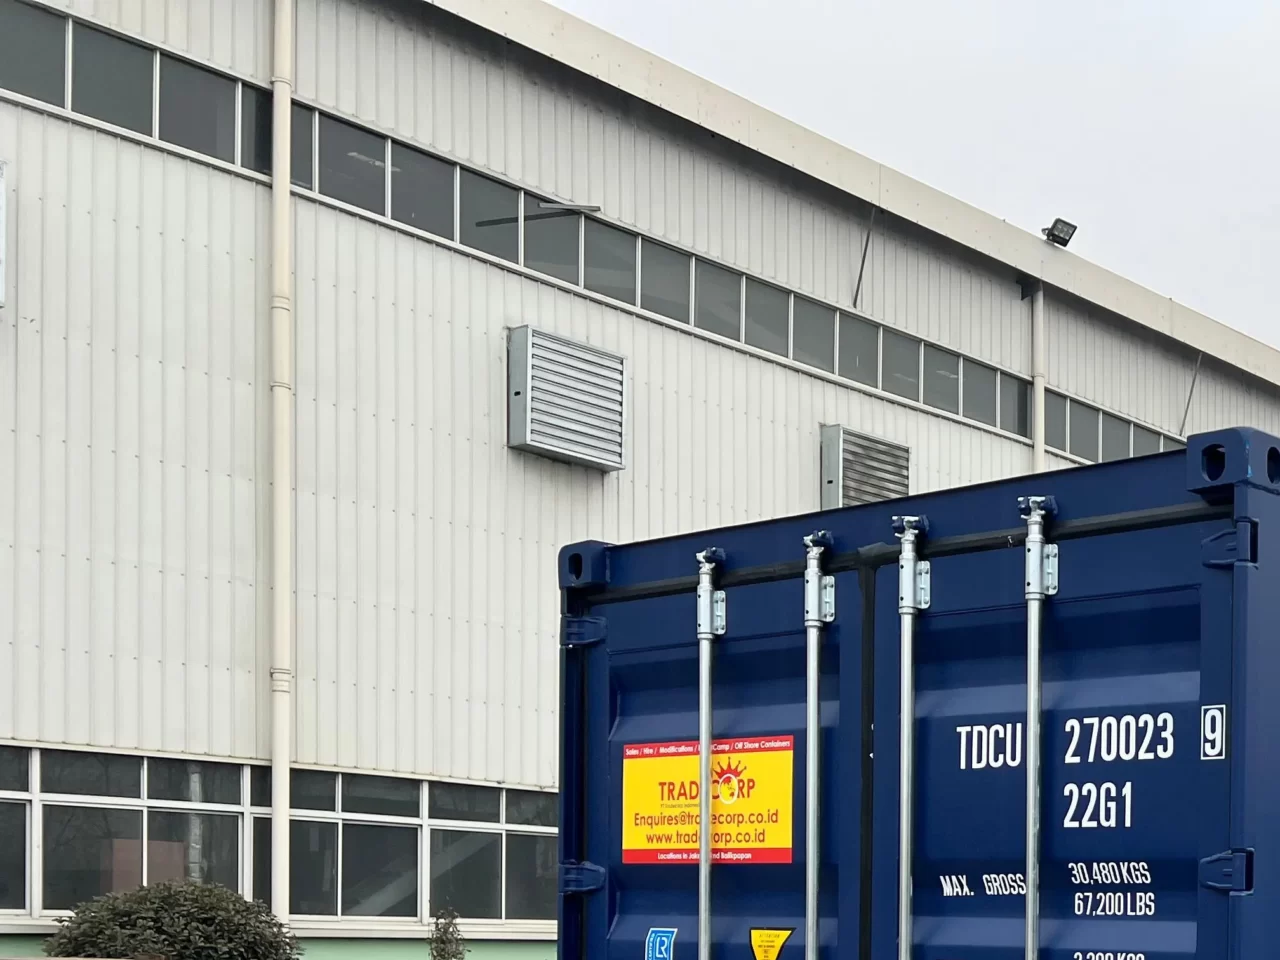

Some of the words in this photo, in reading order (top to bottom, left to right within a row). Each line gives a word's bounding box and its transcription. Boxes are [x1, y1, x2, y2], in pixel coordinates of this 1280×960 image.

[760, 740, 791, 749] Containers
[956, 723, 1022, 770] TDCU
[1064, 713, 1174, 764] 270023
[1203, 707, 1223, 757] 9
[658, 777, 756, 803] TRADCORP
[1063, 781, 1132, 828] 22G1
[634, 809, 779, 829] Enquires@traecorp.co.id
[939, 874, 975, 897] MAX.
[982, 873, 1027, 895] GROSS
[1068, 862, 1121, 885] 30,480
[1120, 862, 1151, 884] KGS
[1074, 892, 1124, 917] 67,200
[1126, 892, 1155, 916] LBS
